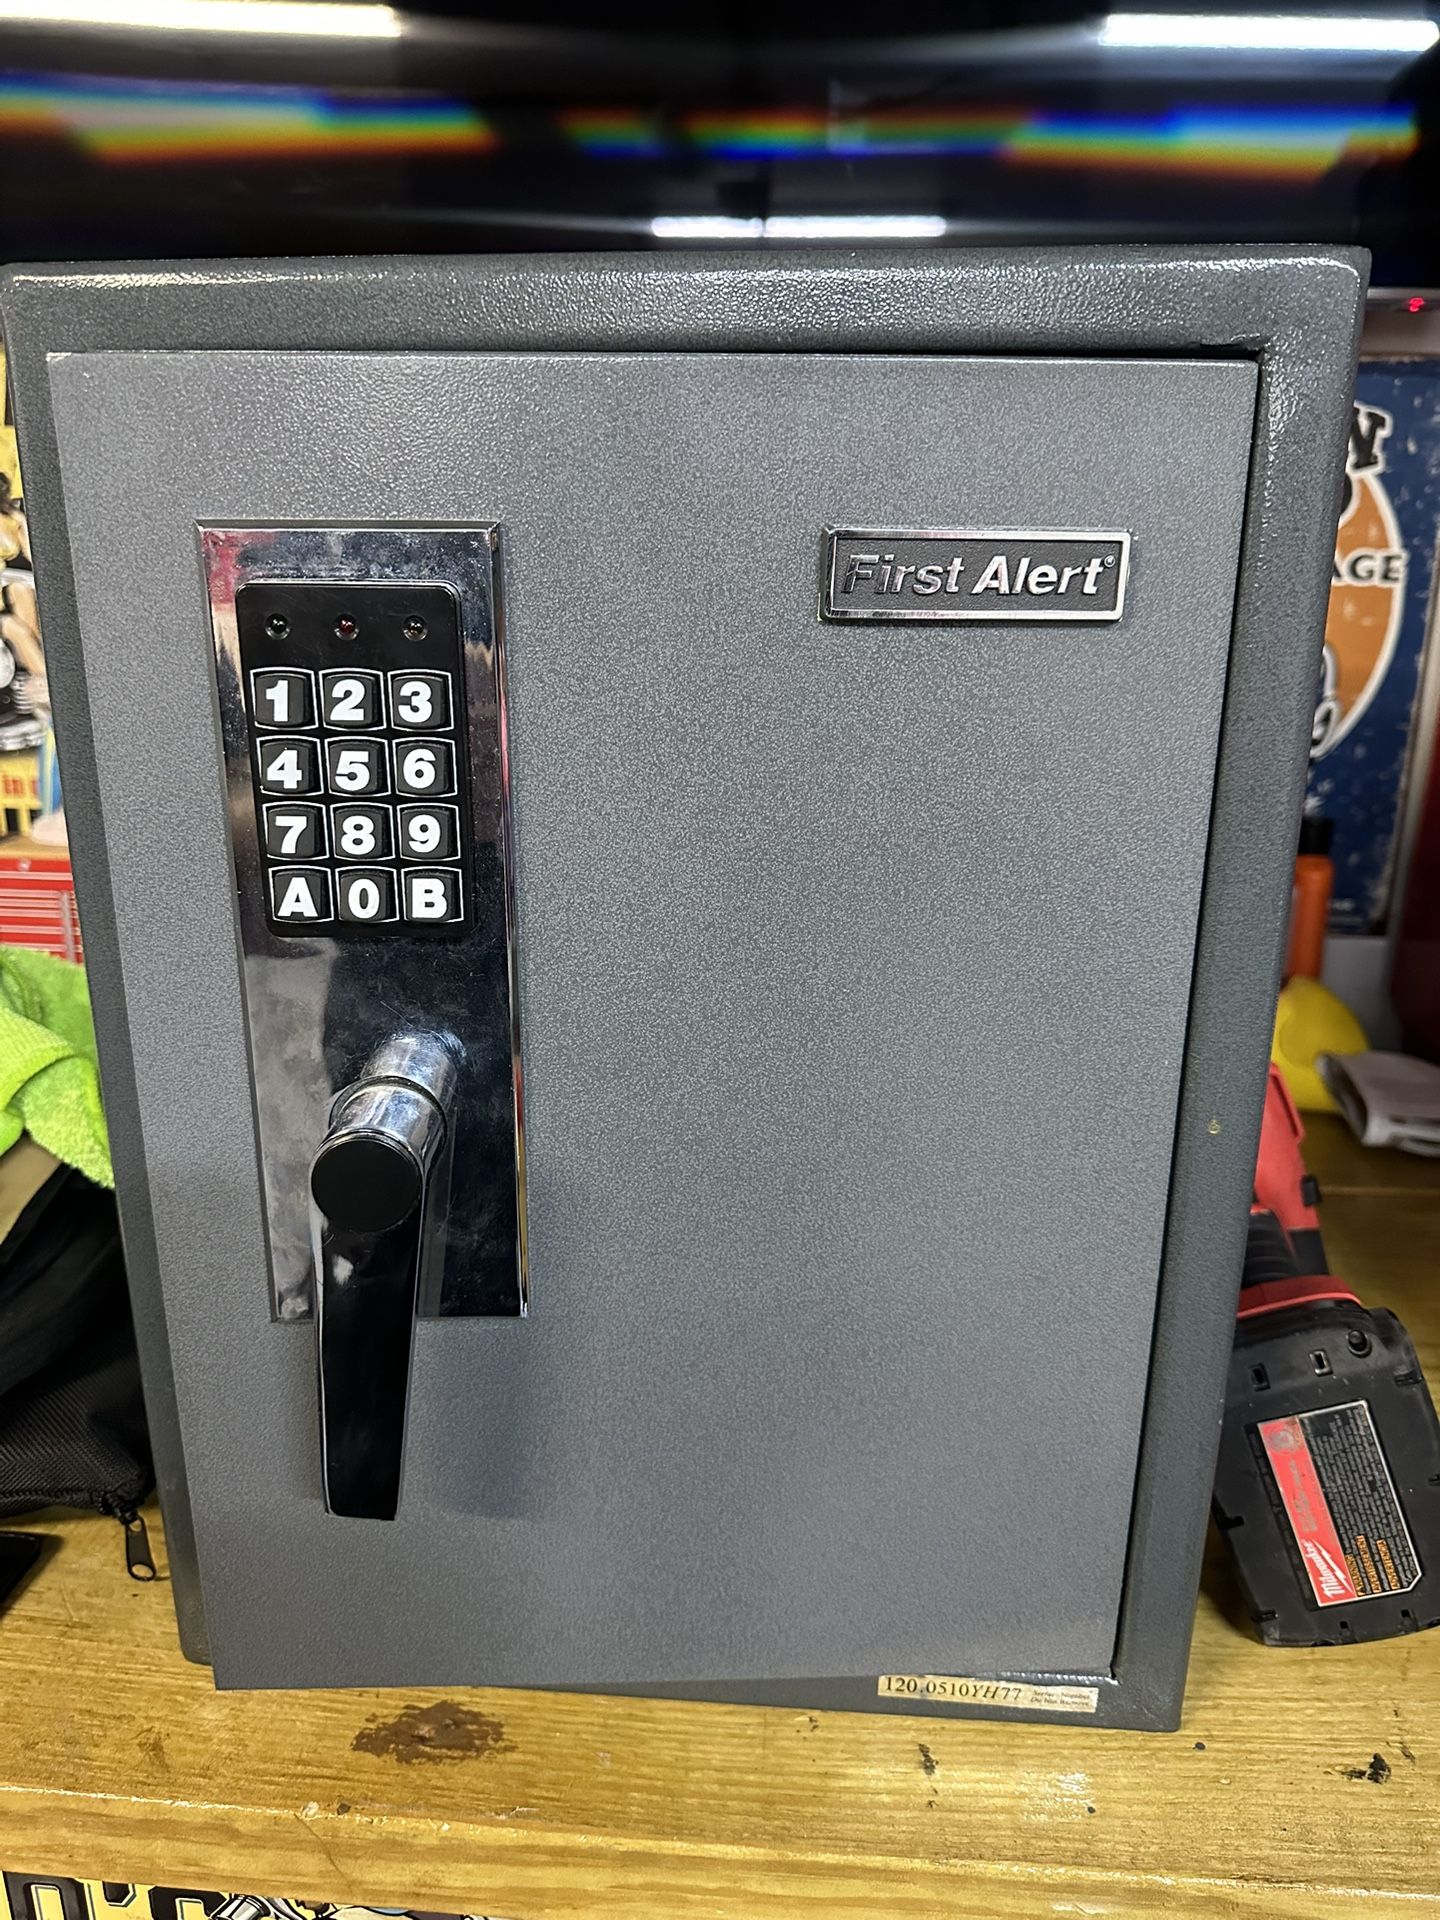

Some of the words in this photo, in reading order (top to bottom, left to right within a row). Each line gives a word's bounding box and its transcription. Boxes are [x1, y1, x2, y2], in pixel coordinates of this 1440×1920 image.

[844, 554, 964, 594] First
[265, 679, 289, 722] 1
[330, 679, 366, 721] 2
[398, 681, 432, 723] 3
[266, 749, 302, 789] 4
[335, 751, 370, 791] 5
[403, 749, 436, 789] 6
[275, 816, 307, 853] 7
[340, 815, 375, 854] 8
[408, 815, 441, 853] 9
[278, 877, 318, 917] A
[348, 878, 380, 918] 0
[412, 878, 447, 918] B
[1302, 1539, 1345, 1598] Milwaukee
